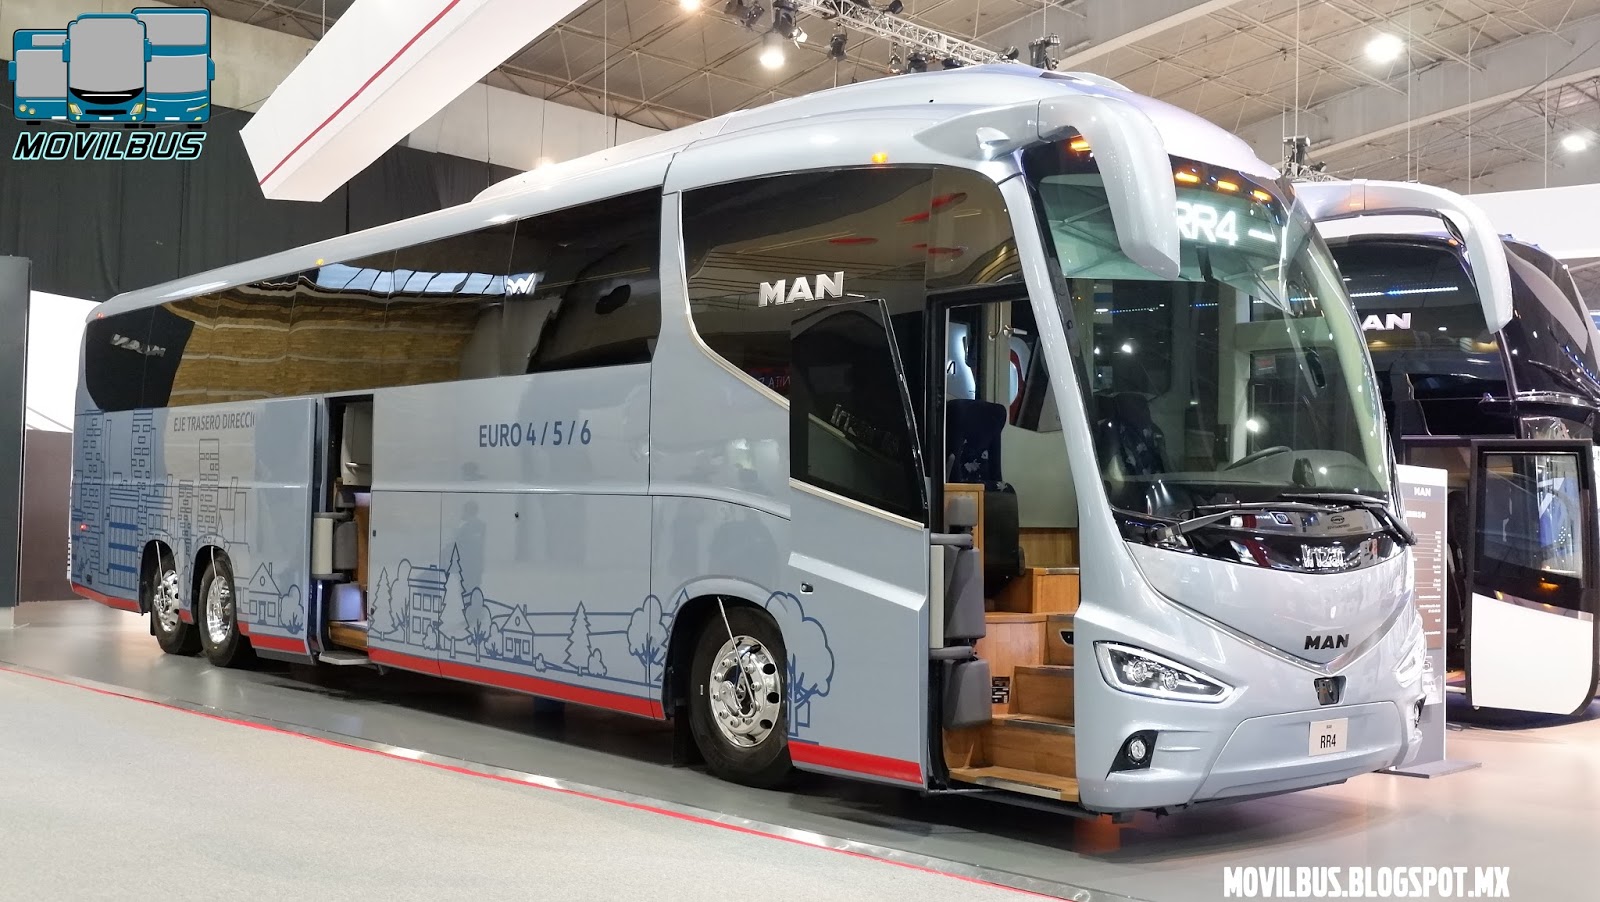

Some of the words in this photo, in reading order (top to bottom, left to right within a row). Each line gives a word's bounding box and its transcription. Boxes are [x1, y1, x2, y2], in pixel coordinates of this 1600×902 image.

[1176, 201, 1239, 246] RR4
[758, 271, 844, 307] MAN
[173, 417, 186, 432] EJE
[187, 414, 221, 431] TRASERO
[222, 411, 256, 429] DIRECCI
[479, 422, 522, 447] EURO
[1304, 634, 1350, 650] MAN
[1320, 734, 1336, 749] RR4
